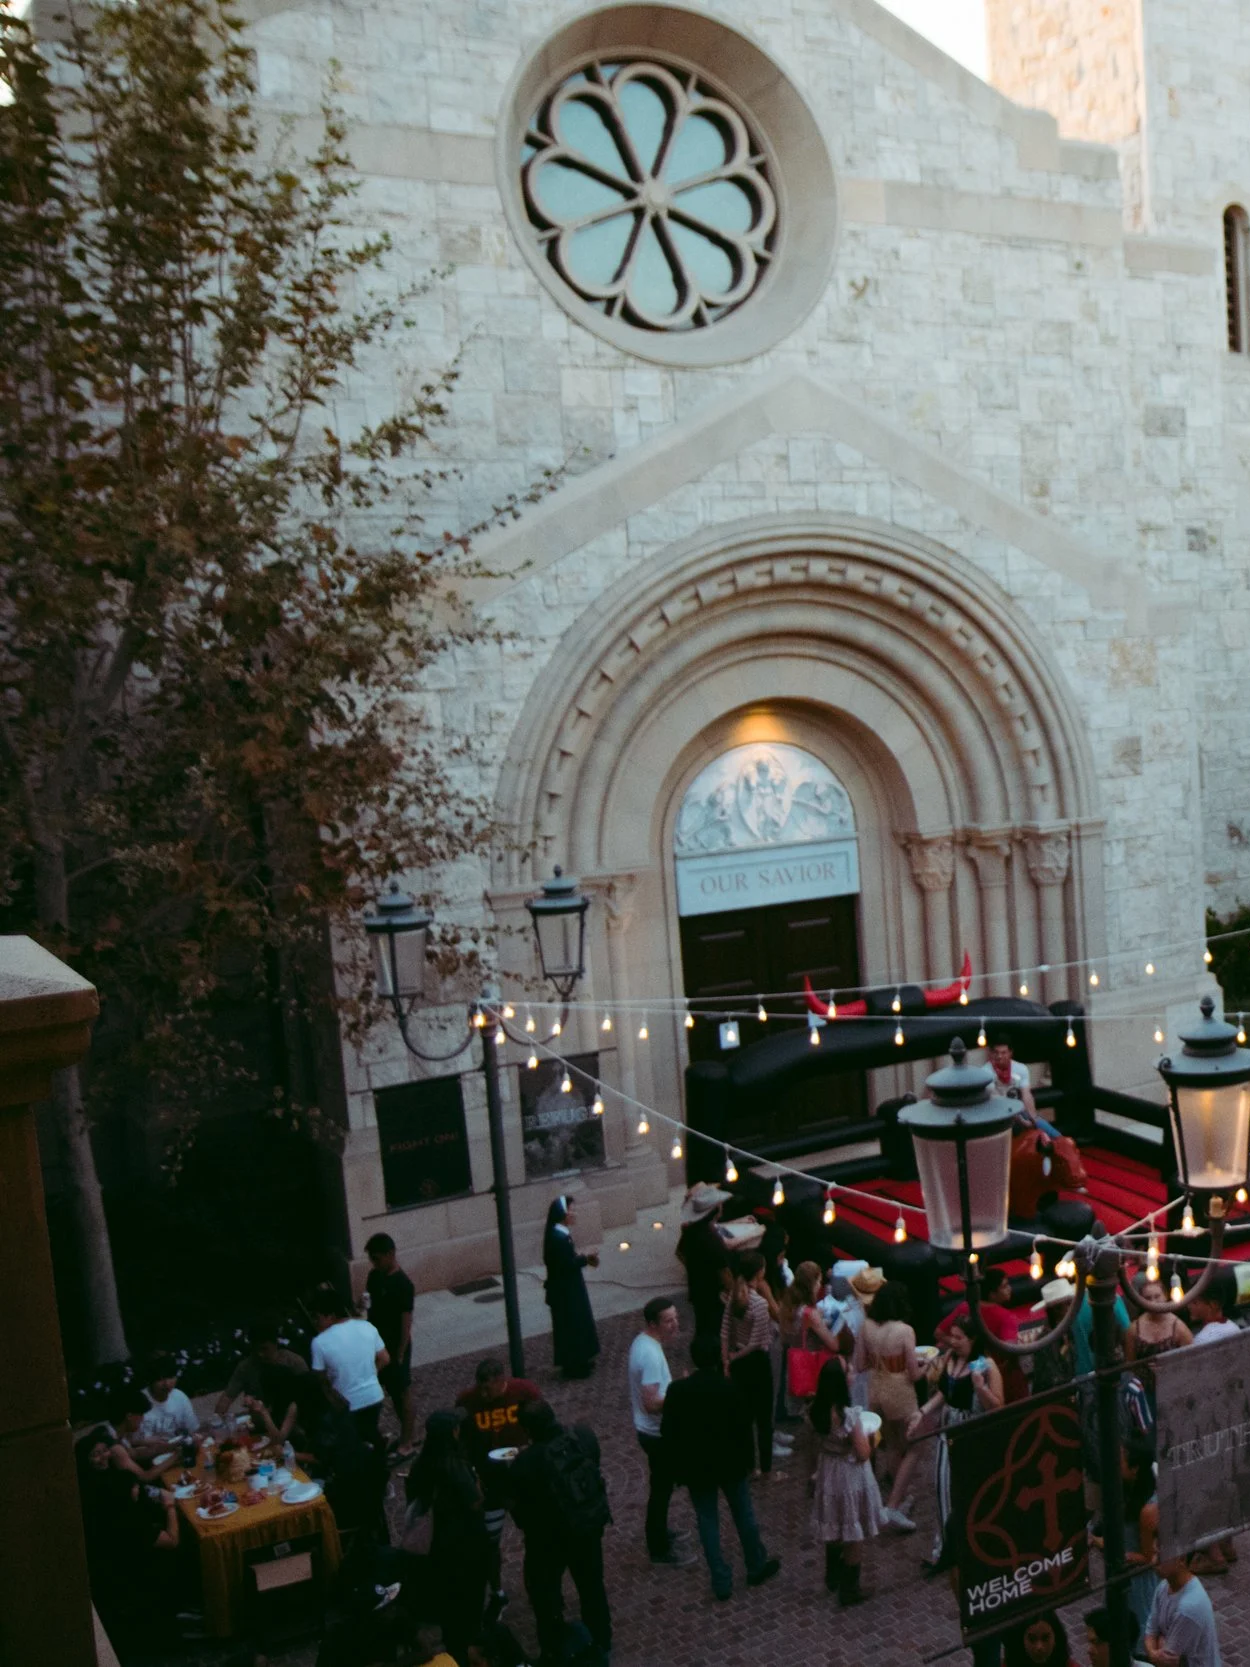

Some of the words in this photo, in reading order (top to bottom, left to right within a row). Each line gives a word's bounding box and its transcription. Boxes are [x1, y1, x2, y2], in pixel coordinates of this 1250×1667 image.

[700, 872, 749, 895] OUR
[758, 861, 836, 886] SAVIOR
[475, 1404, 519, 1430] USC
[967, 1546, 1074, 1601] WELCOME
[968, 1578, 1033, 1616] HOME
